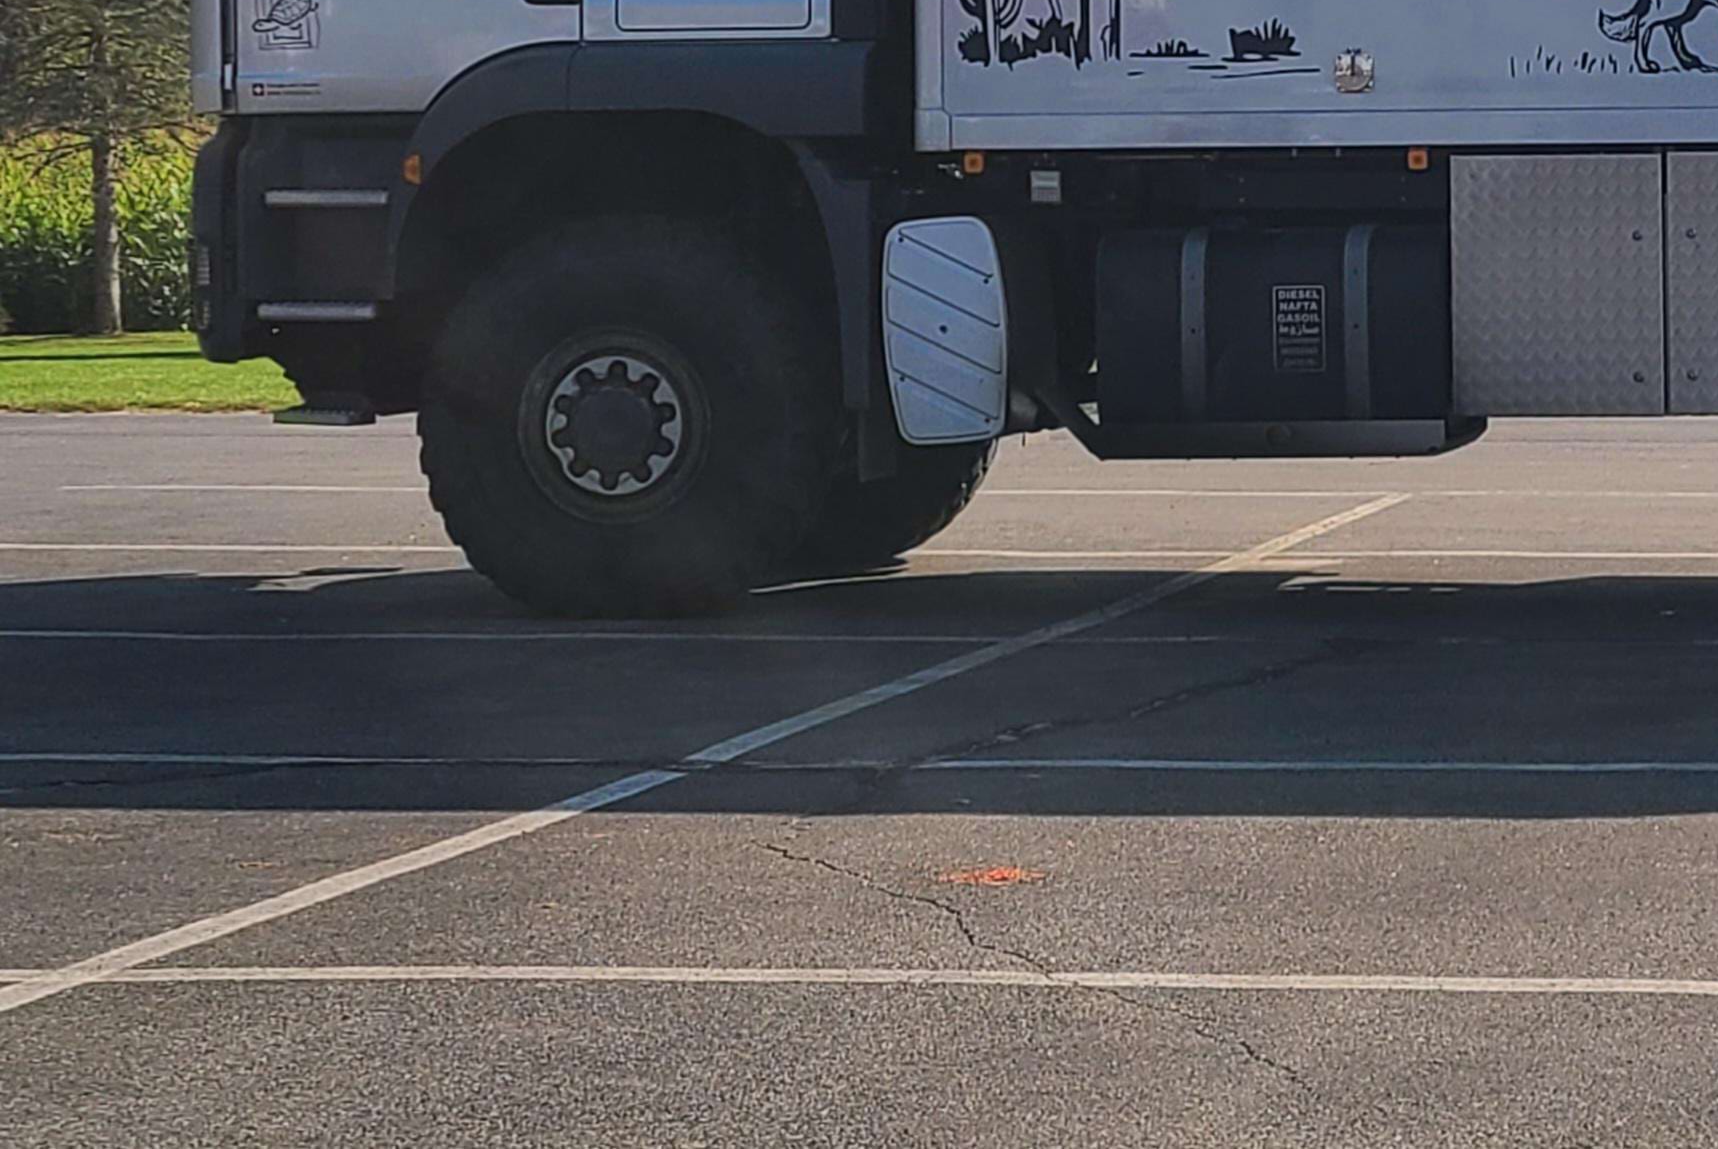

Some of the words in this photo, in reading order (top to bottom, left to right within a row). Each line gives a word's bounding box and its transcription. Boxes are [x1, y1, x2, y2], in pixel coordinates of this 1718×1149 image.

[1278, 290, 1320, 300] DIESEL
[1279, 301, 1318, 311] NAFTA
[1277, 313, 1320, 323] GASOIL
